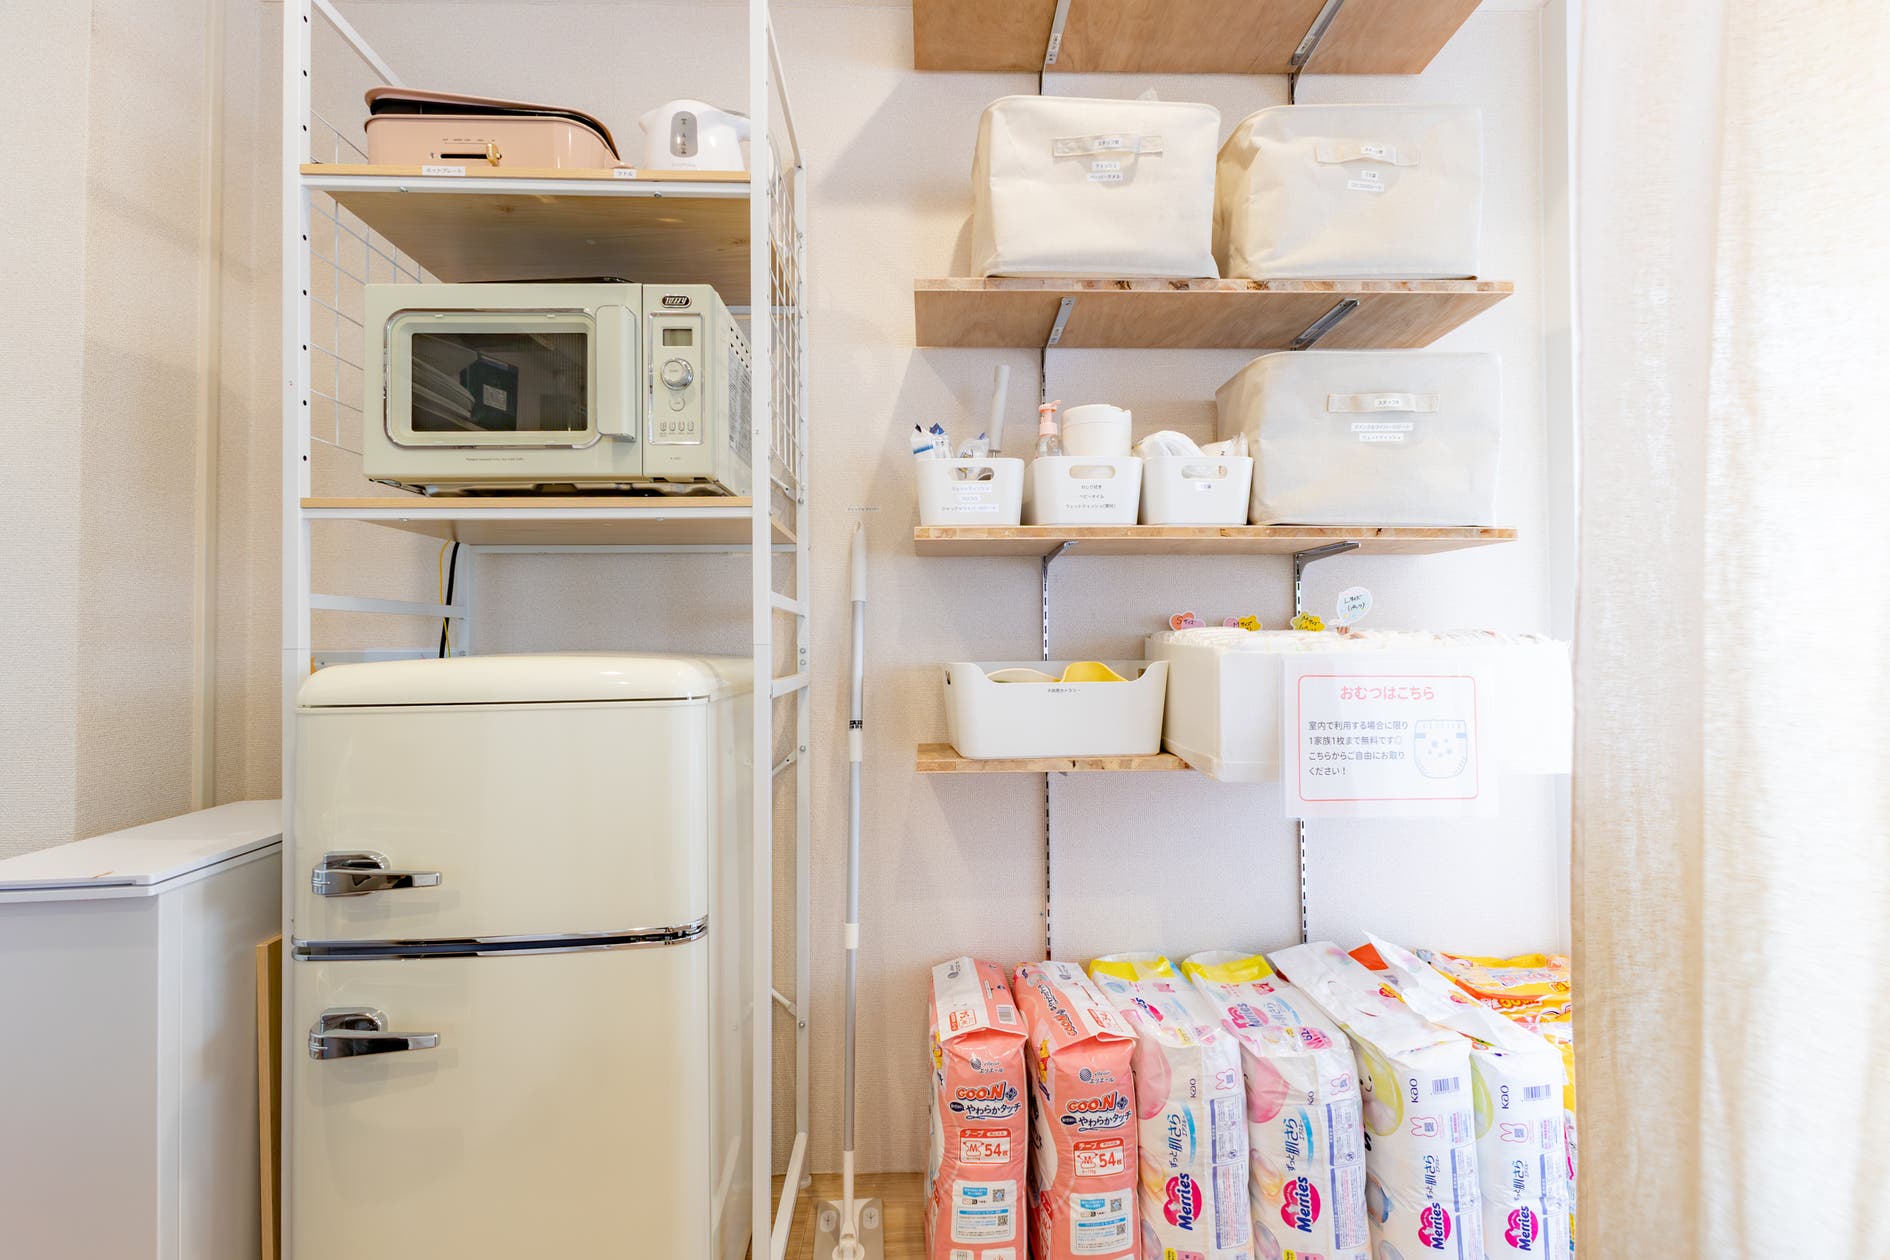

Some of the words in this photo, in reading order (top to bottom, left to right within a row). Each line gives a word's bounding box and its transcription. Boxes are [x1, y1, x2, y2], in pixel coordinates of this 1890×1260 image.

[1340, 686, 1435, 700] おむつはこちら
[1308, 721, 1408, 731] 室内で利用する場合に限り
[1308, 751, 1405, 761] こちらからご自由にお取り
[1409, 1078, 1419, 1103] kao
[1500, 1085, 1510, 1110] kao
[966, 1102, 1021, 1116] やわらかタッチ
[1079, 1110, 1131, 1127] やわらかタッチ
[1167, 1114, 1183, 1168] ずっと肌さら
[1283, 1118, 1300, 1171] ずっと肌さら
[1177, 1173, 1193, 1231] Merries
[1294, 1176, 1313, 1233] Merries
[1431, 1202, 1445, 1250] Merries
[1518, 1206, 1532, 1252] Merries
